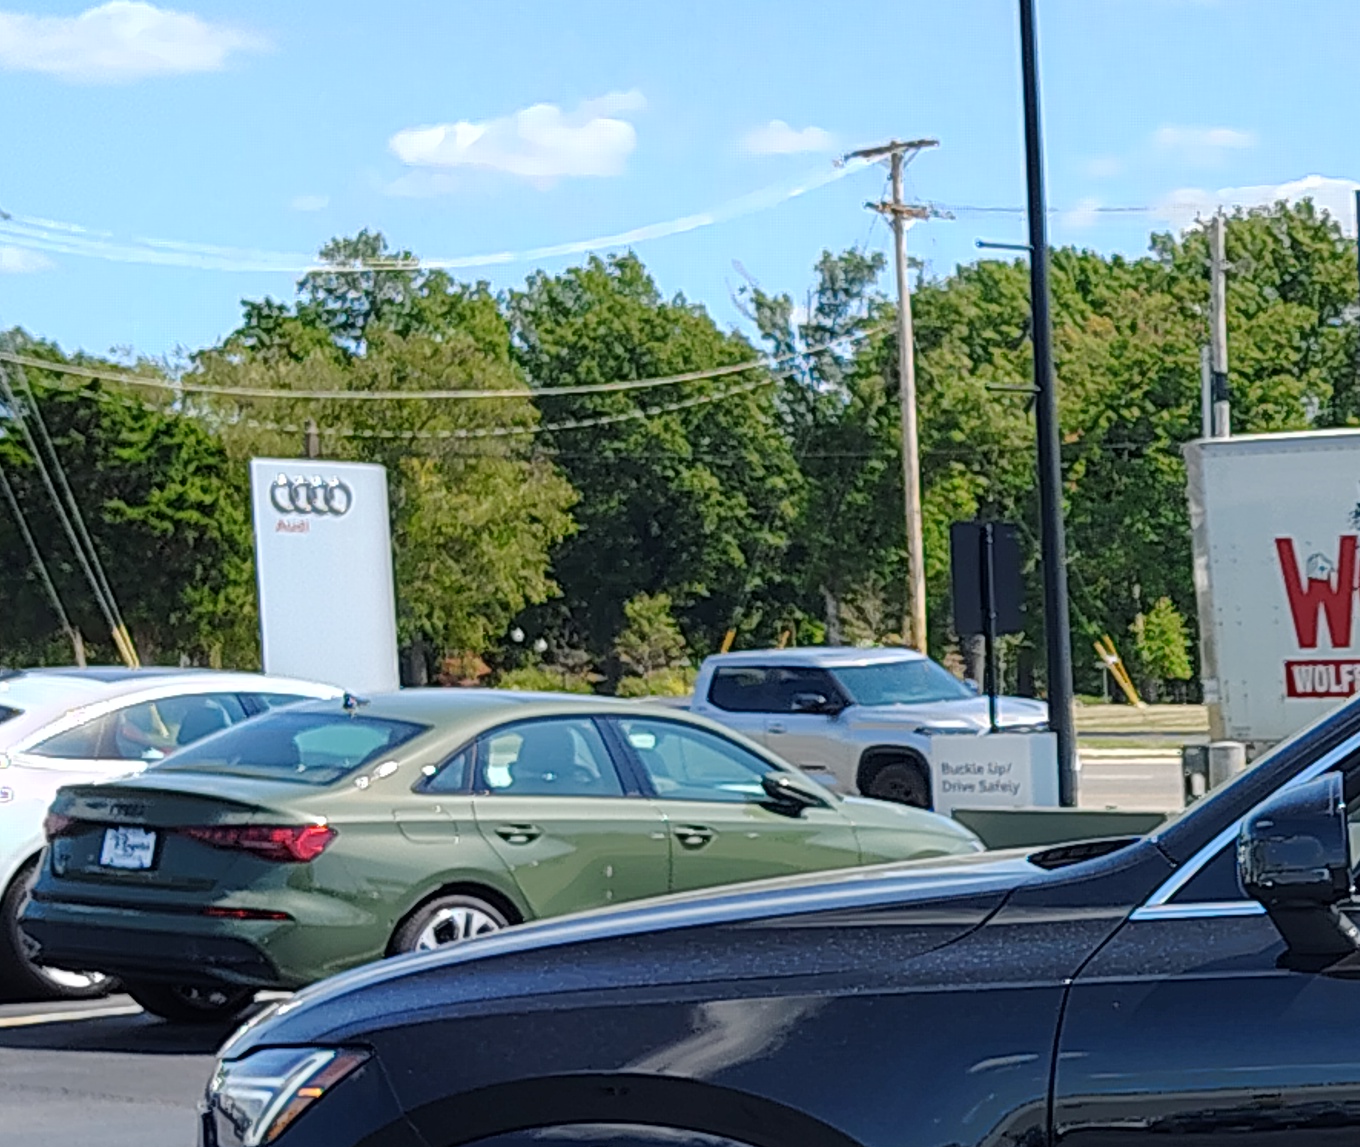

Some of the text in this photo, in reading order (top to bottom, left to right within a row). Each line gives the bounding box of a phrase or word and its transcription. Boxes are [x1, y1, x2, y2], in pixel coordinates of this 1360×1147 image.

[275, 519, 310, 533] Audi
[941, 762, 984, 775] Buckle
[942, 780, 1021, 796] Drive Safety
